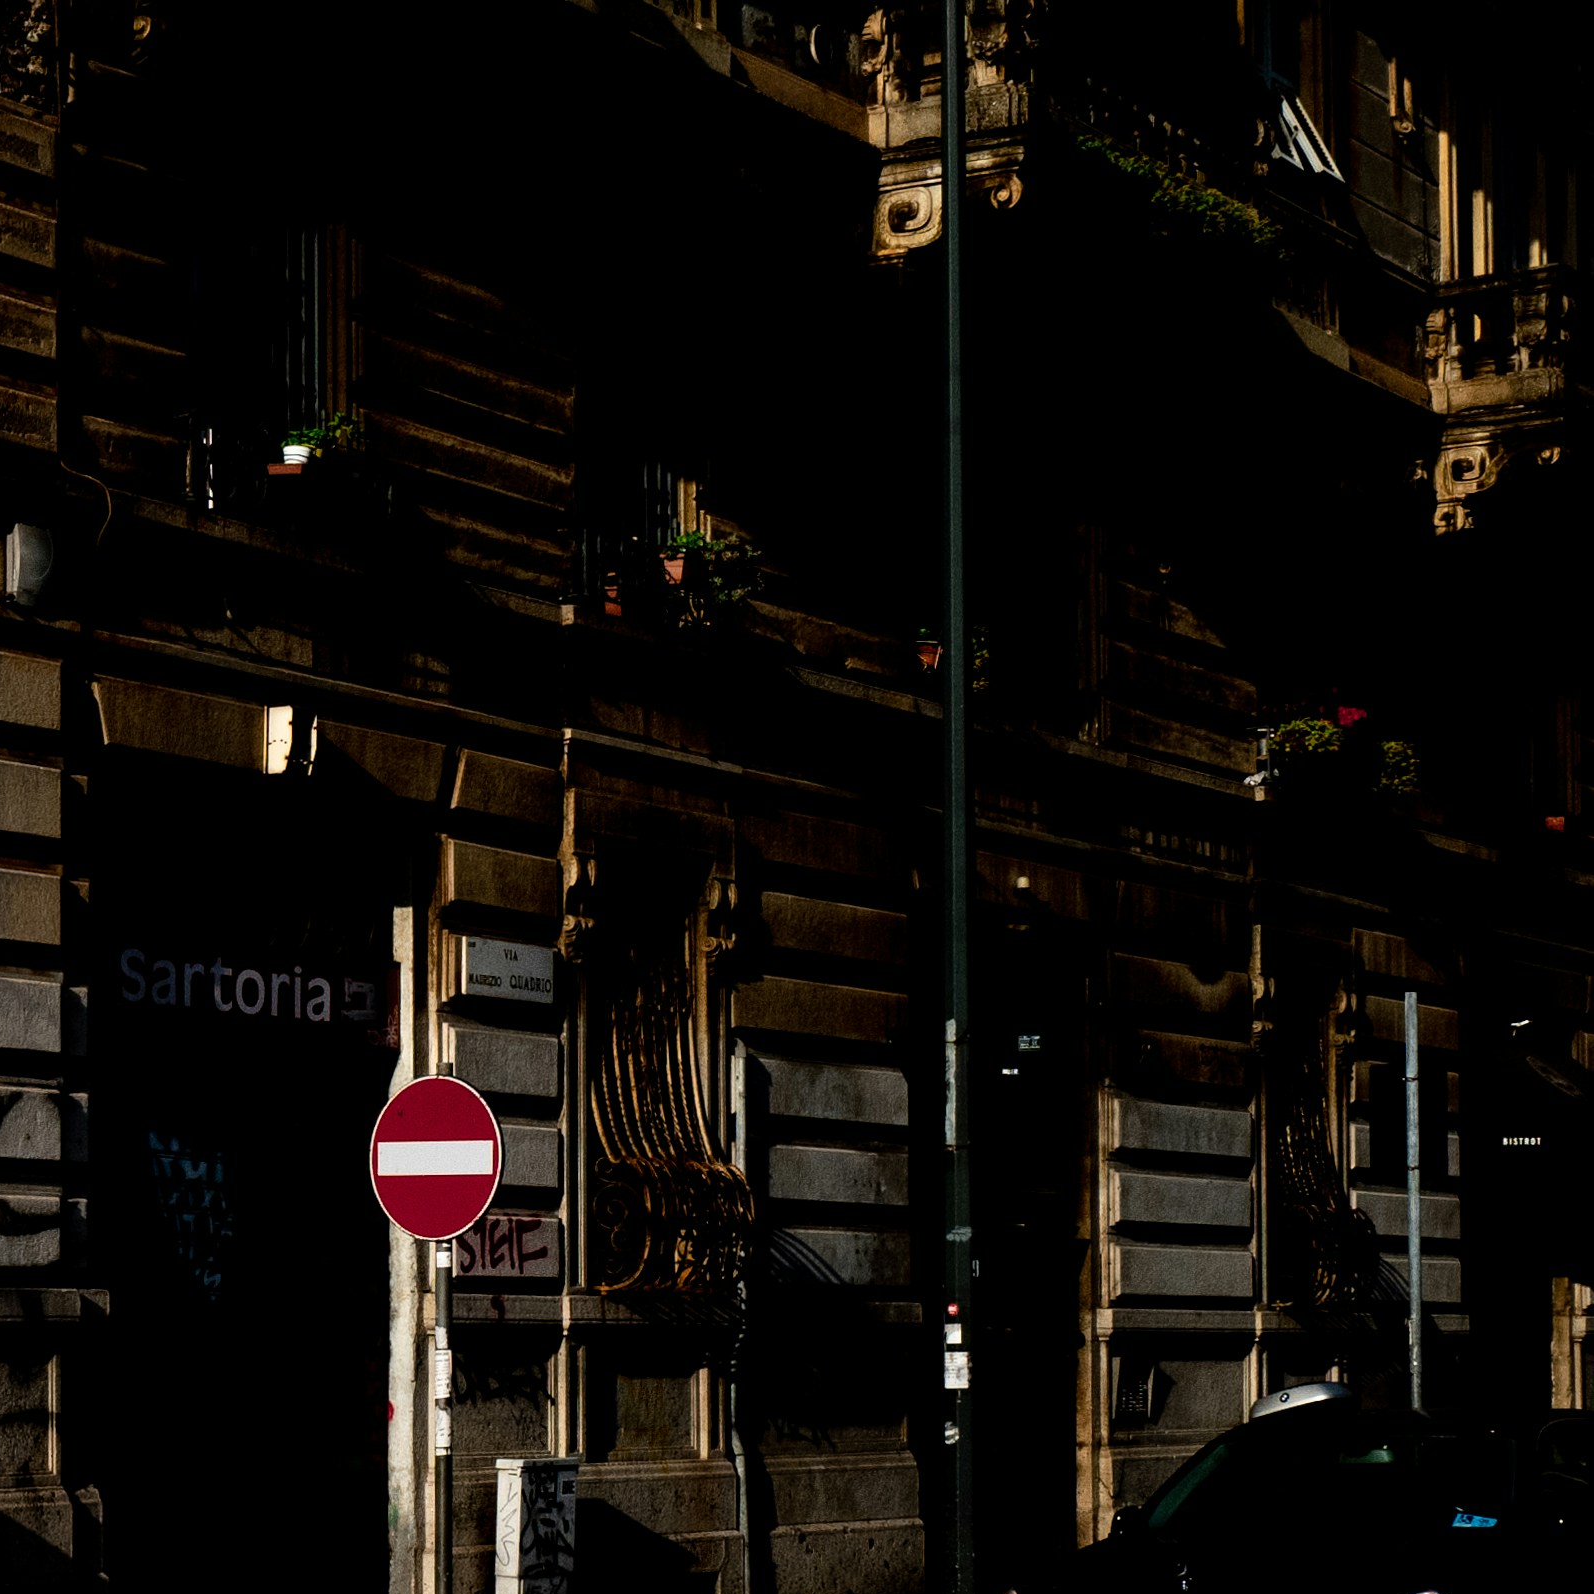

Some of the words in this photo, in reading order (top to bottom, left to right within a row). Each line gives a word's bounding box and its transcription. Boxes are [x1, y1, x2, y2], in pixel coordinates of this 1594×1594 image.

[503, 948, 519, 961] VIA
[120, 947, 332, 1023] Sartoria
[509, 974, 552, 994] QUADRIO
[1502, 1137, 1542, 1146] BISTROT
